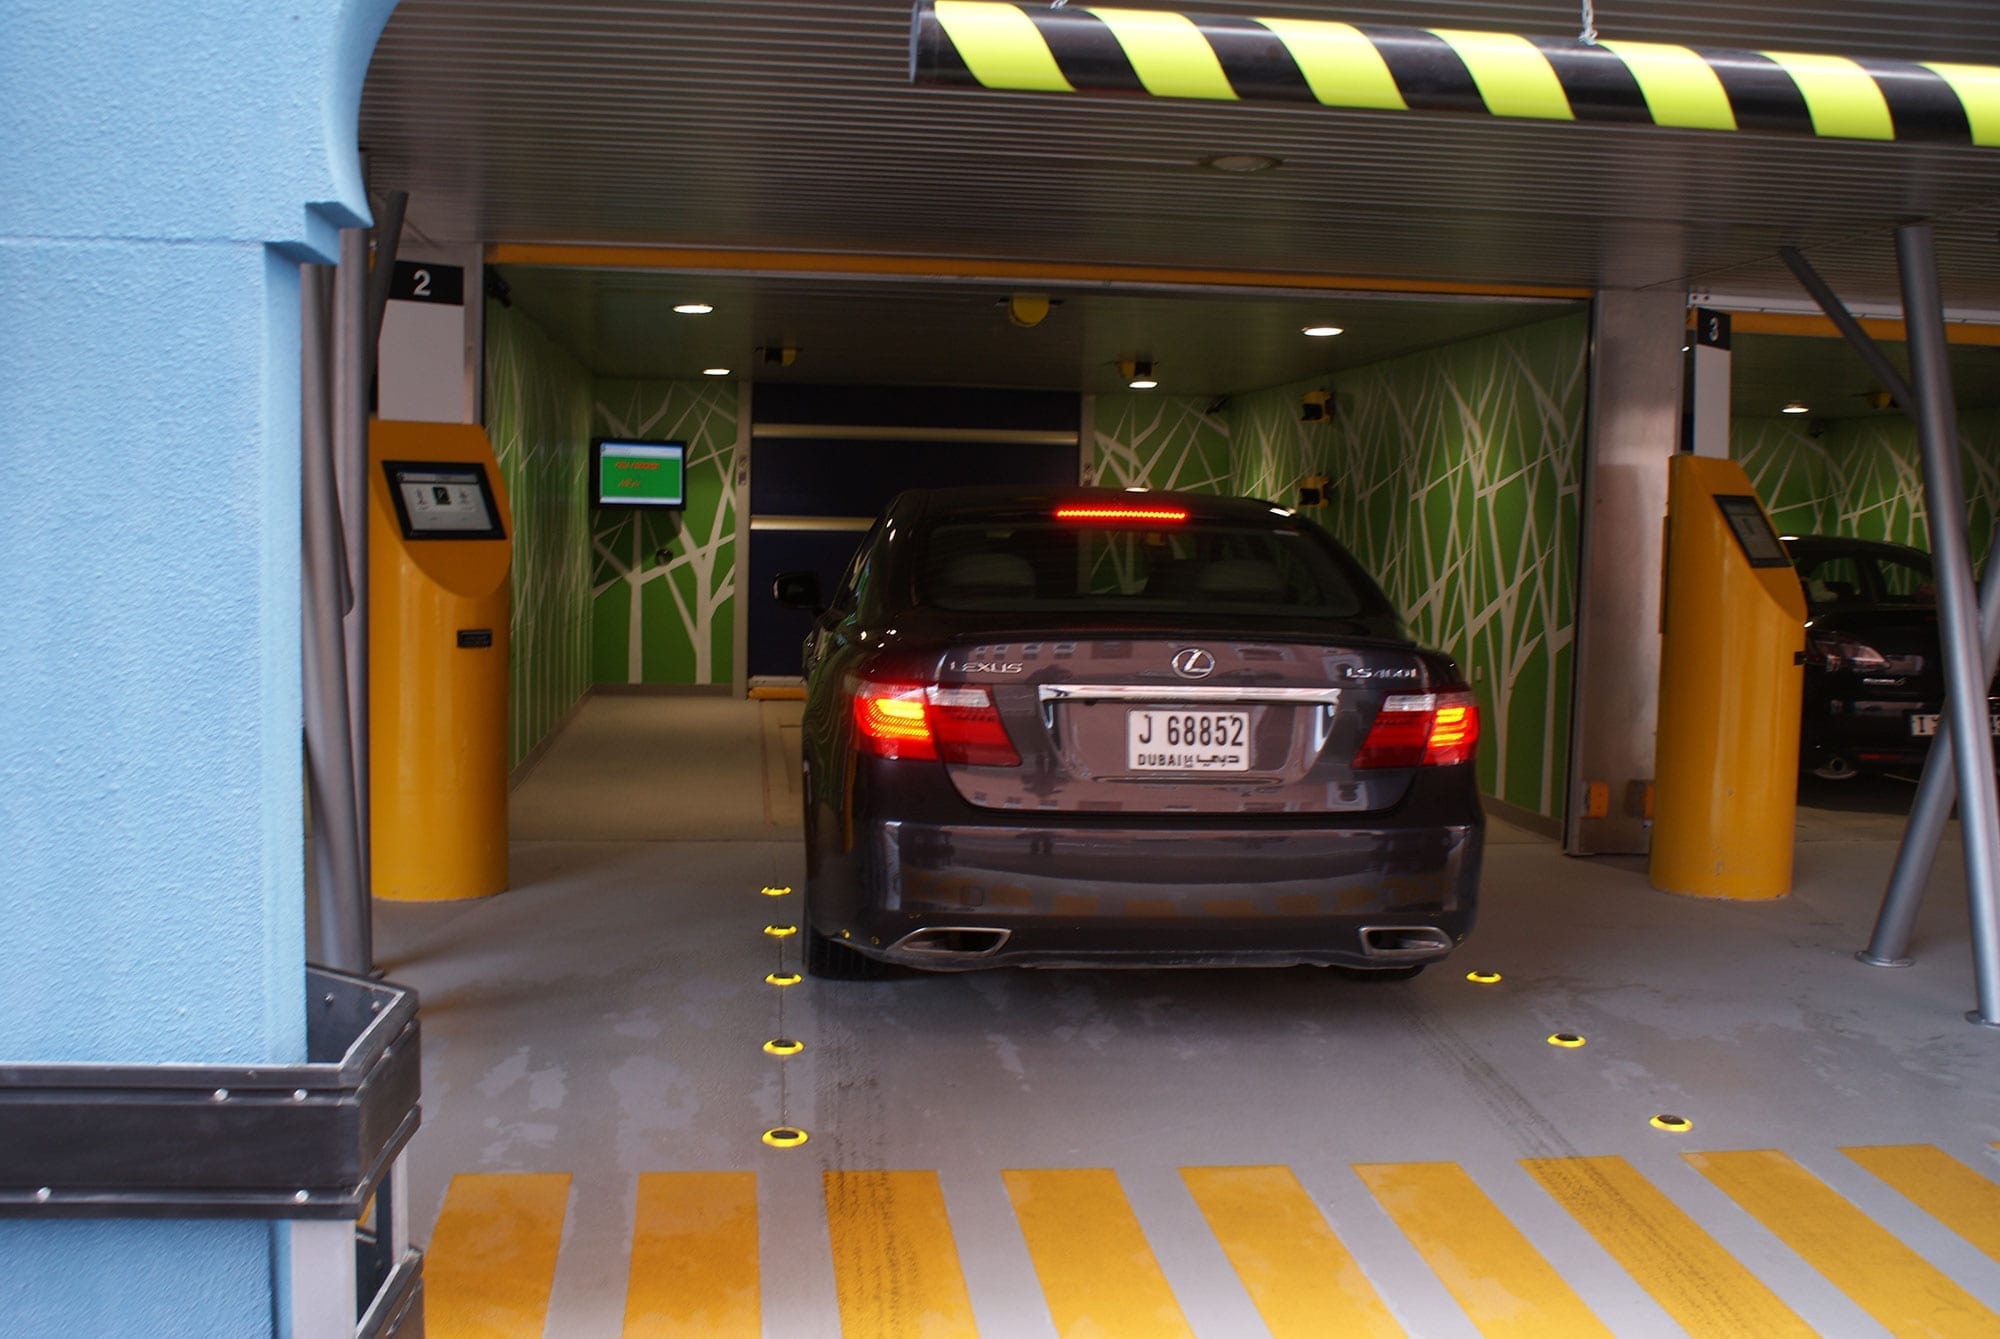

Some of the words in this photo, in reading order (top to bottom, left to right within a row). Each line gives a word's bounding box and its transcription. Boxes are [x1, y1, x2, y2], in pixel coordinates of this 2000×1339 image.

[413, 268, 432, 297] 2
[1709, 316, 1720, 342] 3
[950, 661, 1024, 674] LEXUS
[1138, 714, 1152, 744] J
[1167, 715, 1244, 747] 68852
[1137, 753, 1183, 767] DUBAI
